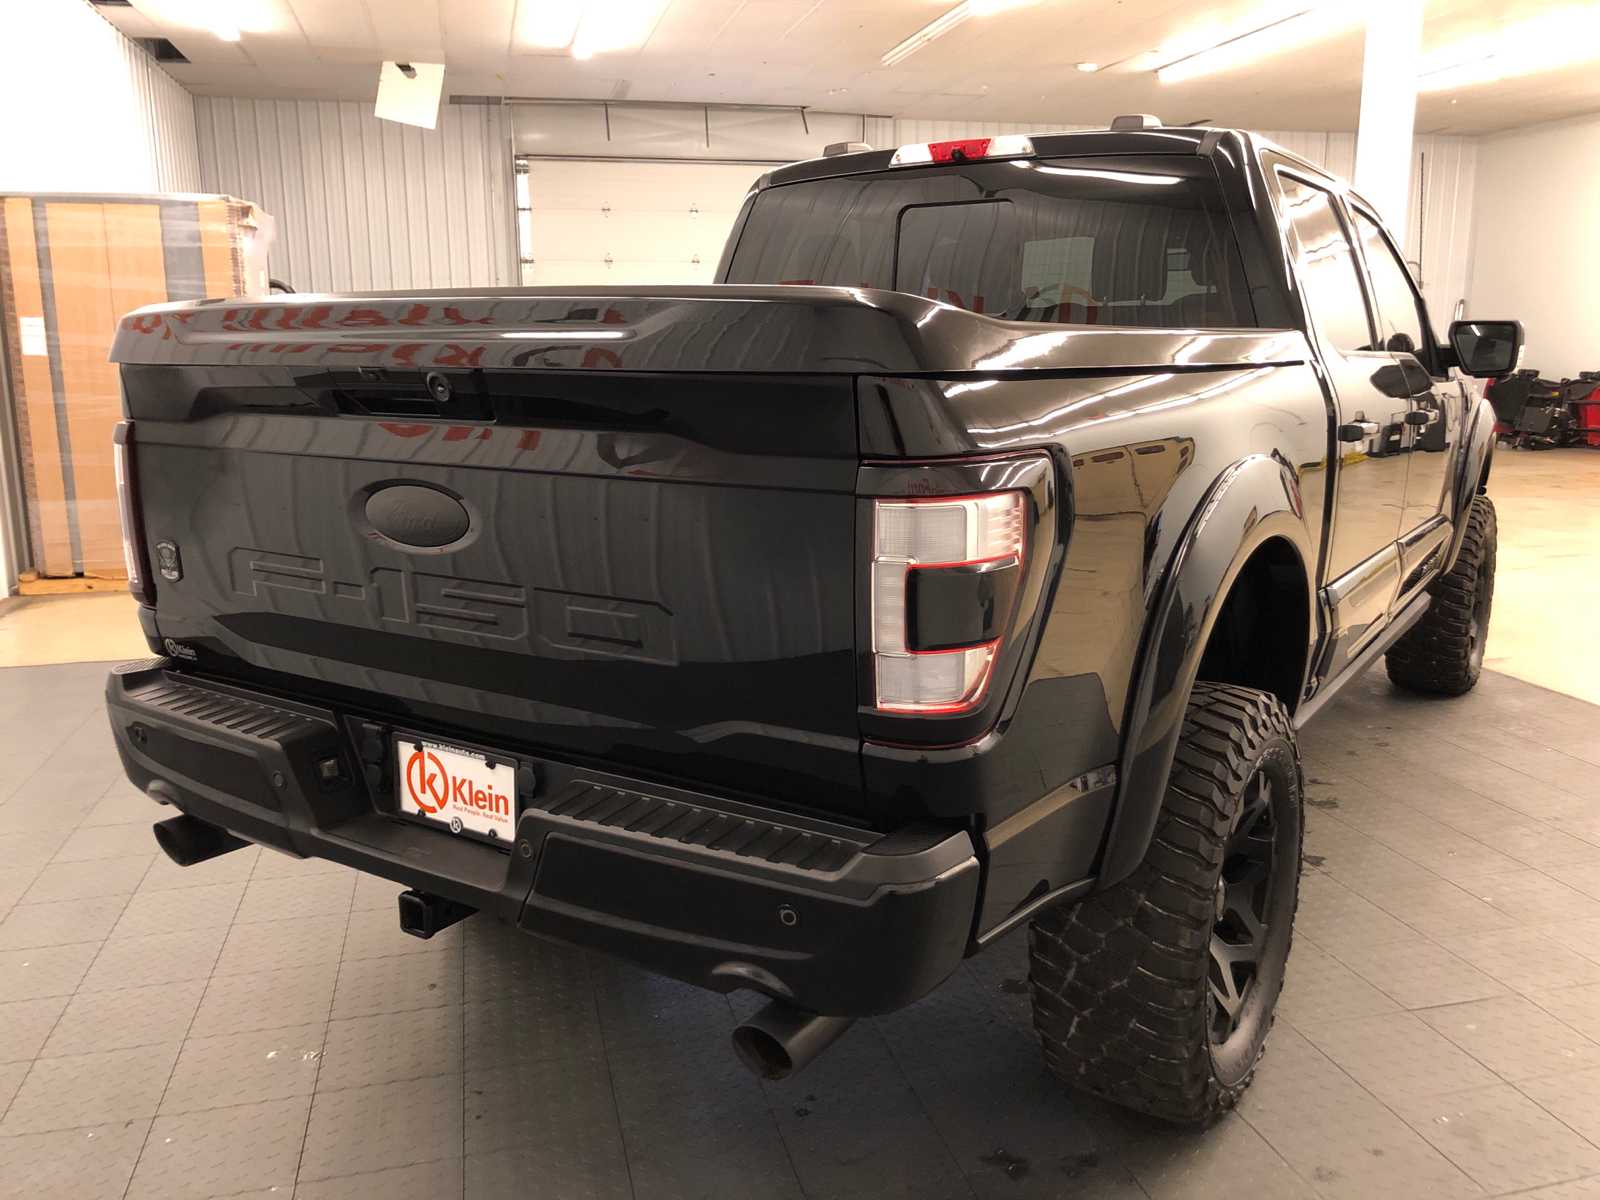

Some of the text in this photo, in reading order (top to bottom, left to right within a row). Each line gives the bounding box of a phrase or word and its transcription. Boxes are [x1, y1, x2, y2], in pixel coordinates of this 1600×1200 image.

[386, 499, 442, 532] Ford
[228, 547, 679, 667] F-150
[421, 741, 486, 761] www.kleinauto.com
[452, 776, 509, 816] Klein
[464, 807, 481, 816] People.
[494, 815, 509, 823] Value.
